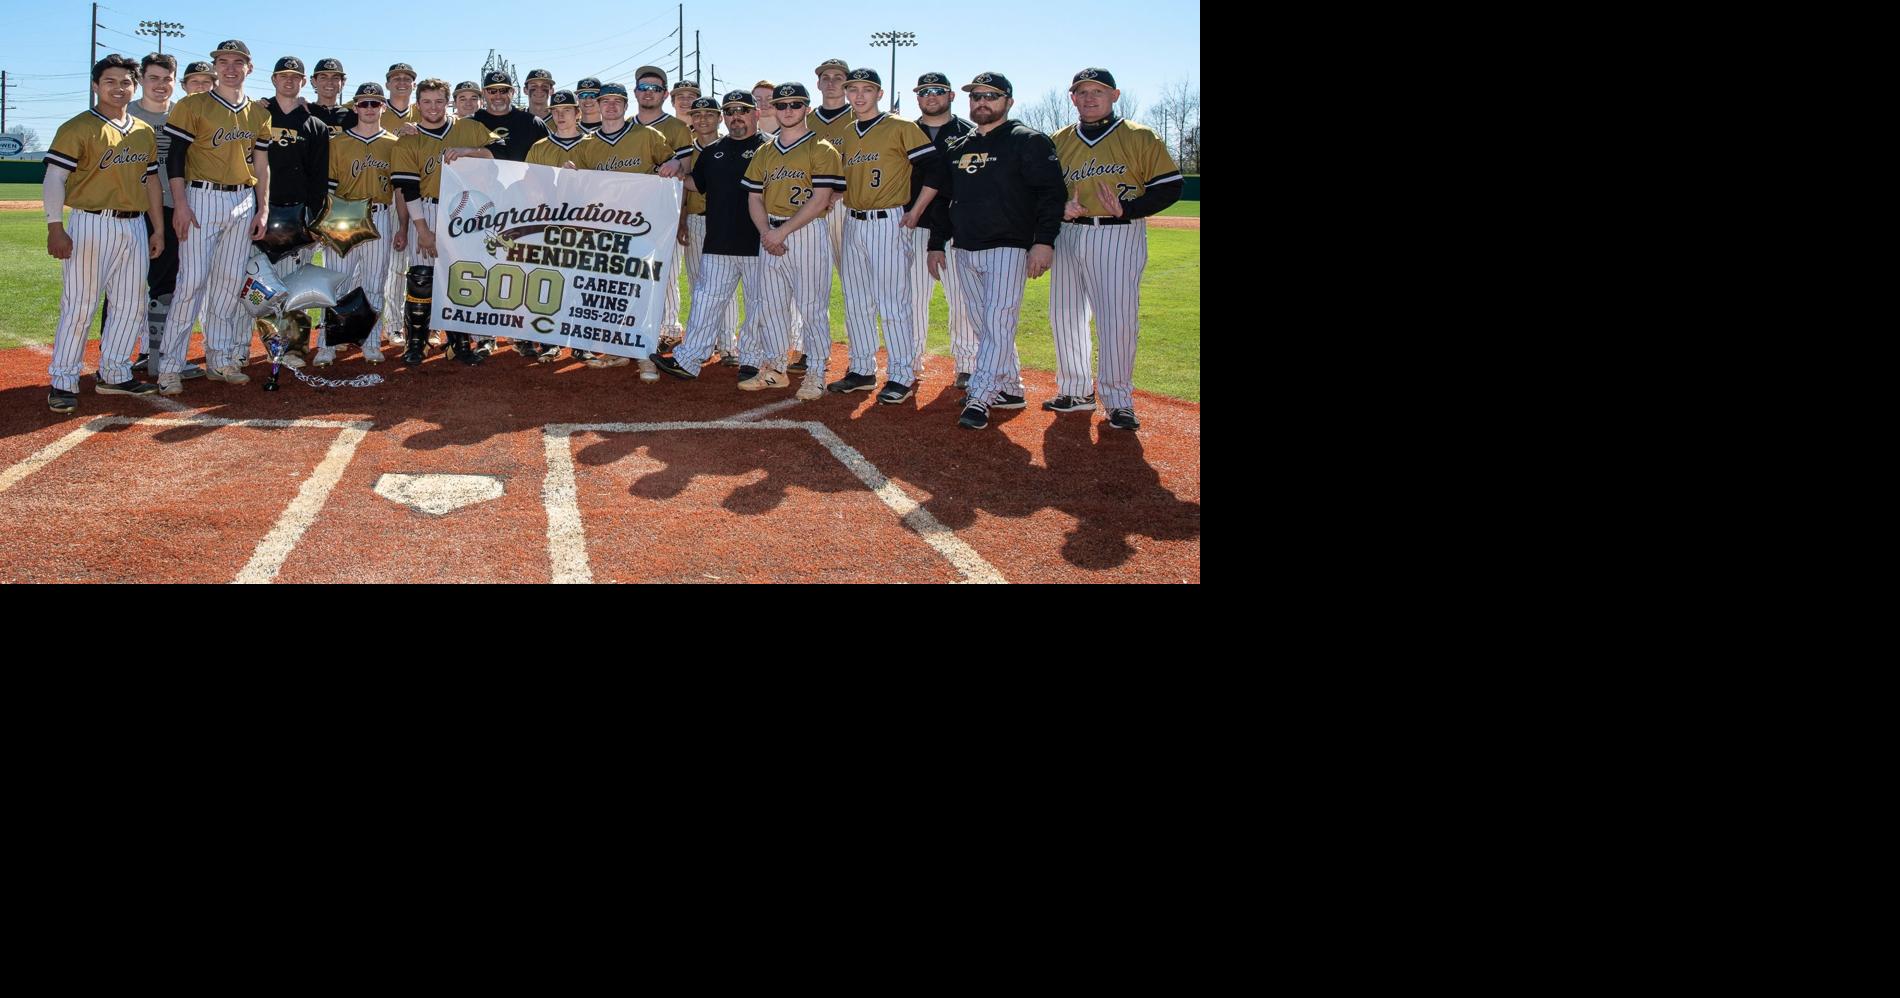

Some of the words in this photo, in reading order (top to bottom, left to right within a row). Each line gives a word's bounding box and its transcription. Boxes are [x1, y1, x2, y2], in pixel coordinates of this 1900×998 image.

[869, 168, 882, 189] 3
[789, 185, 814, 206] 23
[448, 202, 648, 238] Congratulations
[544, 225, 633, 254] COACH
[506, 242, 662, 281] HENDERSON
[447, 260, 565, 316] 600
[573, 275, 642, 299] CAREER
[581, 292, 629, 312] WINS
[441, 307, 525, 328] CALHOUN
[560, 322, 646, 348] BASEBALL
[568, 306, 636, 327] 1995-2020
